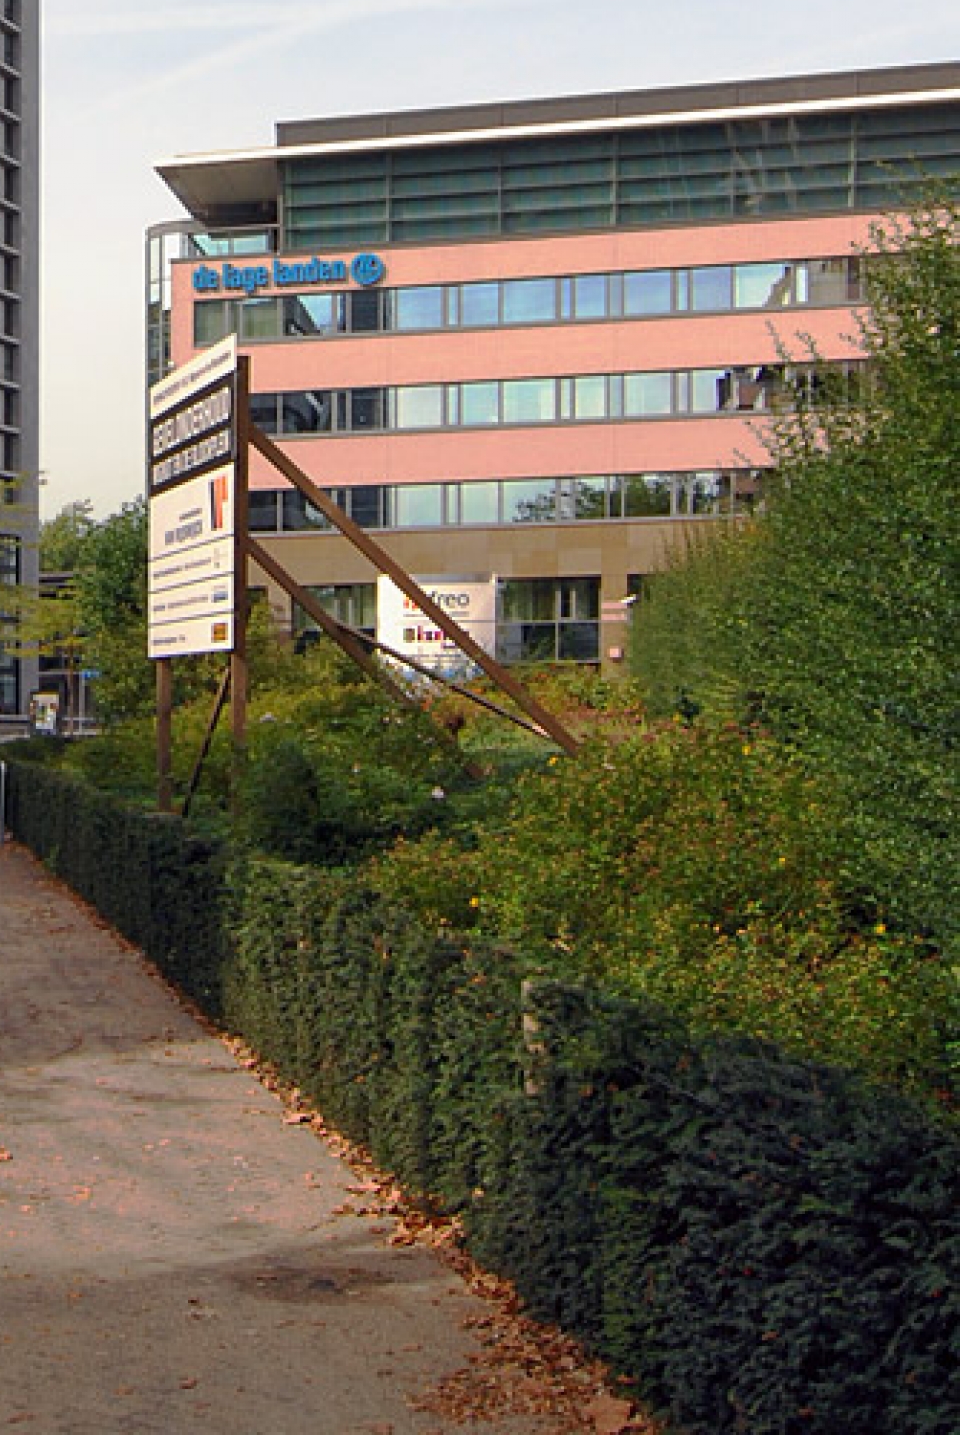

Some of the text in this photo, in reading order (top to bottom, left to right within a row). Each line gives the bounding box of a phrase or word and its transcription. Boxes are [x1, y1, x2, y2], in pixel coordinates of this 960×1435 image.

[193, 255, 346, 295] de lage landen
